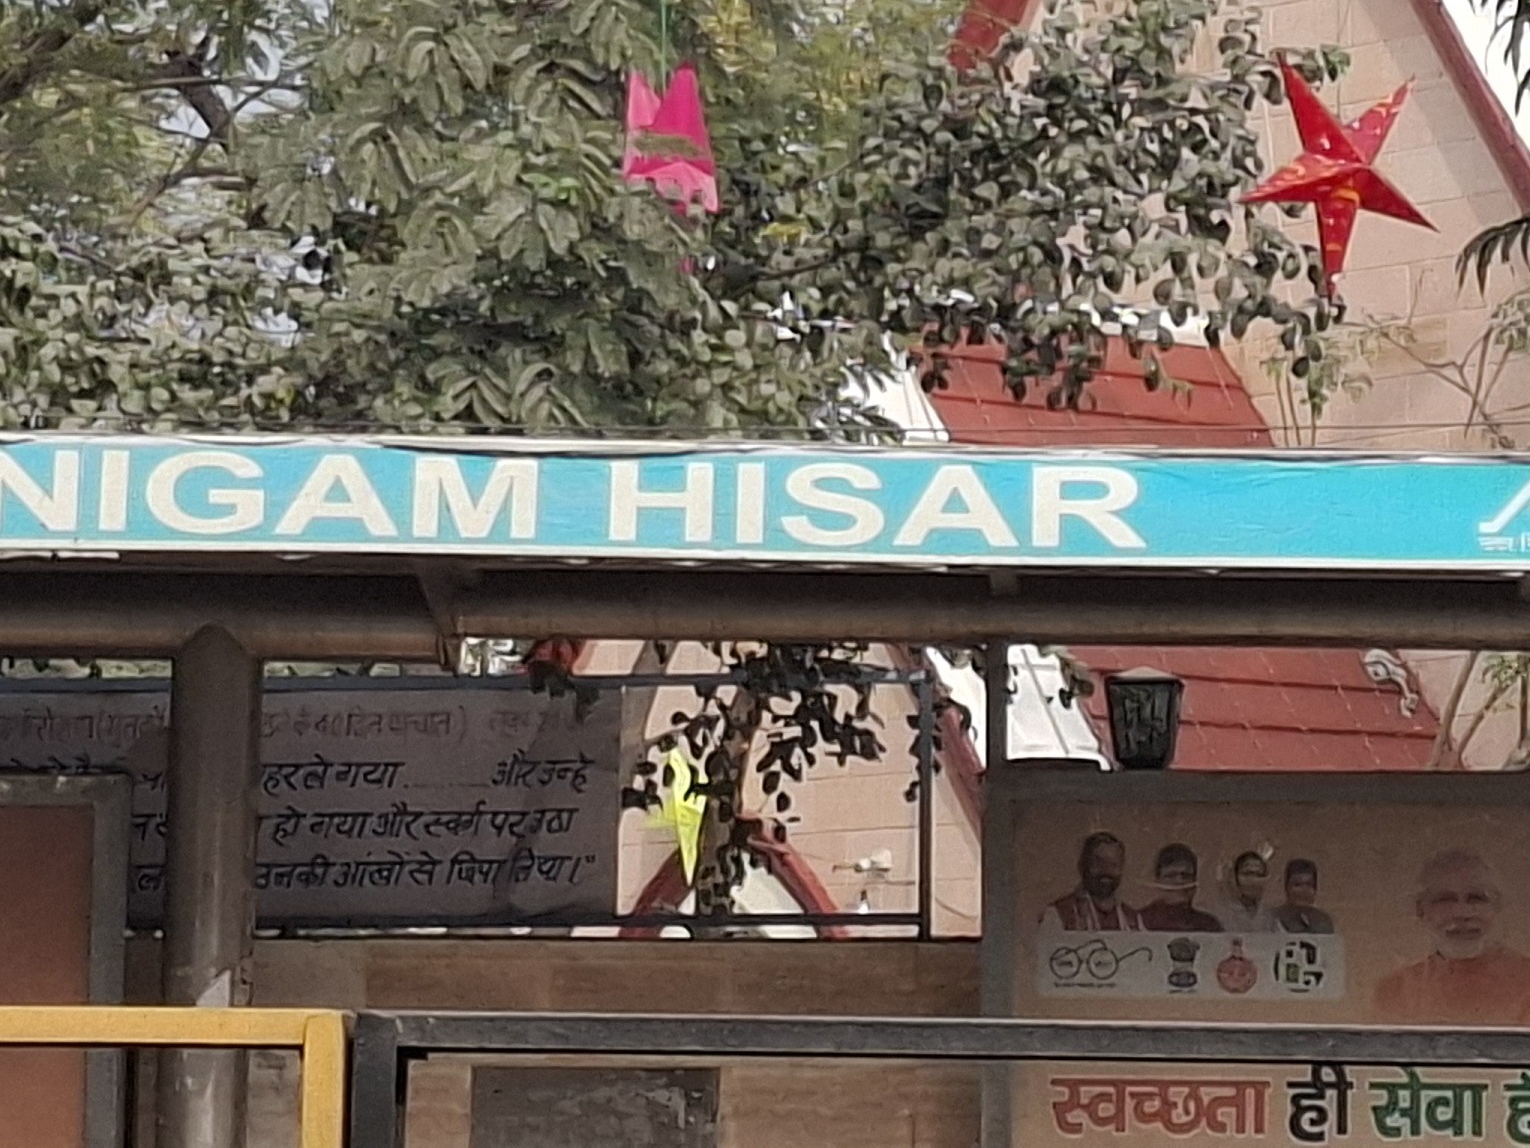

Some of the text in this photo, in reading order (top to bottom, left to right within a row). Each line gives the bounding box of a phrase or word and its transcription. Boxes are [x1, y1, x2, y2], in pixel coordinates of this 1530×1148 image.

[0, 449, 1146, 548] NIGAM HISAR
[335, 762, 405, 788] गया
[309, 810, 371, 840] गया
[1051, 1078, 1270, 1136] स्वच्छता
[1286, 1063, 1354, 1143] ही
[1368, 1066, 1488, 1138] सेवा
